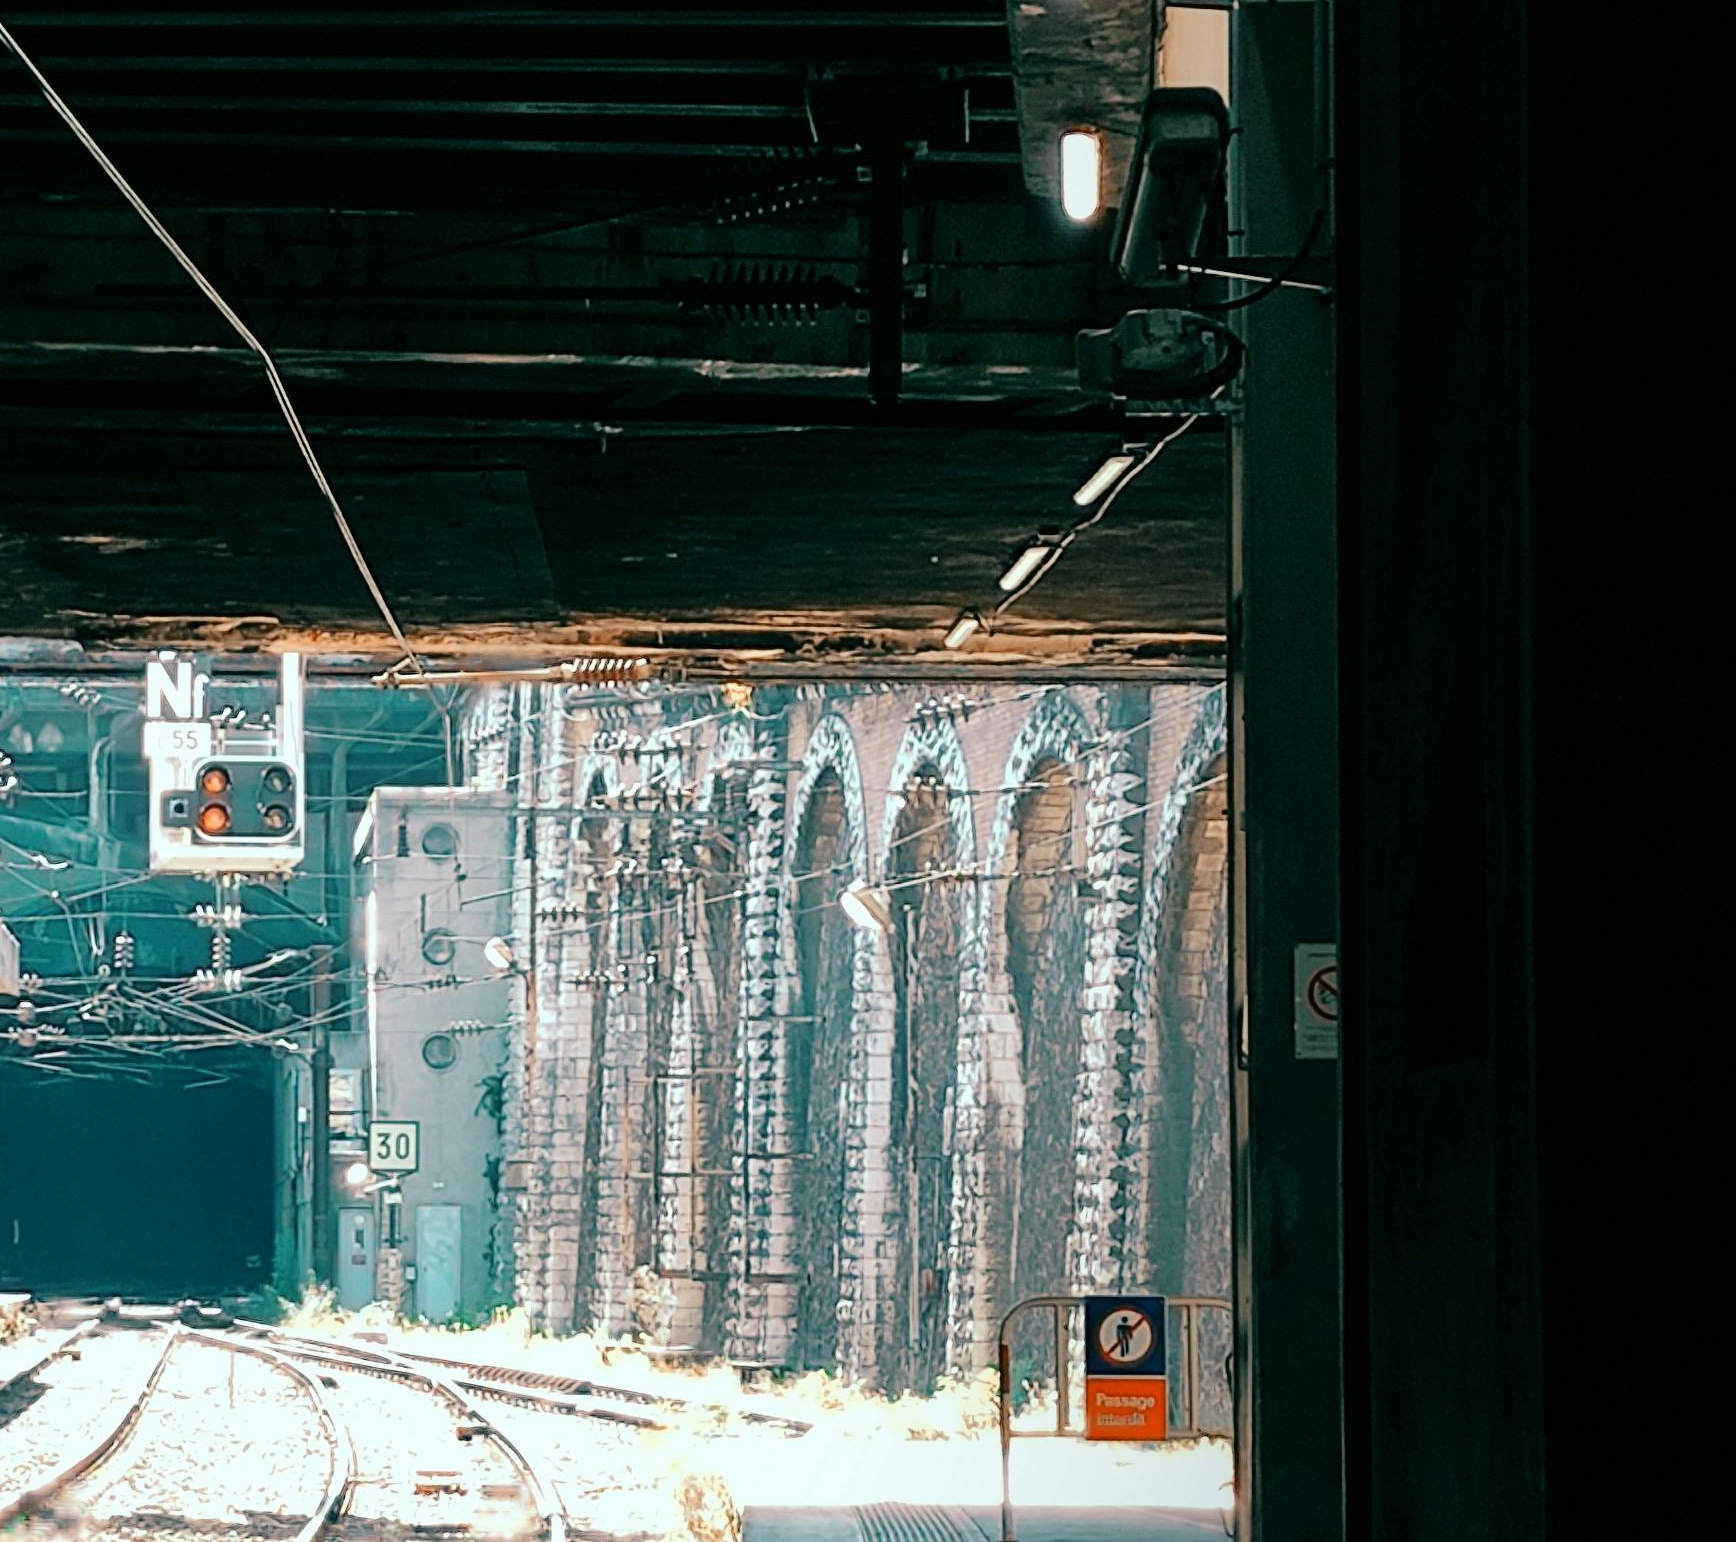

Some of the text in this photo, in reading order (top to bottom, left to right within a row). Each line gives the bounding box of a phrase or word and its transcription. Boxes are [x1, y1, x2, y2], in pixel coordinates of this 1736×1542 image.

[147, 662, 210, 718] Nf
[376, 1132, 410, 1160] 30
[1096, 1392, 1155, 1411] Passage
